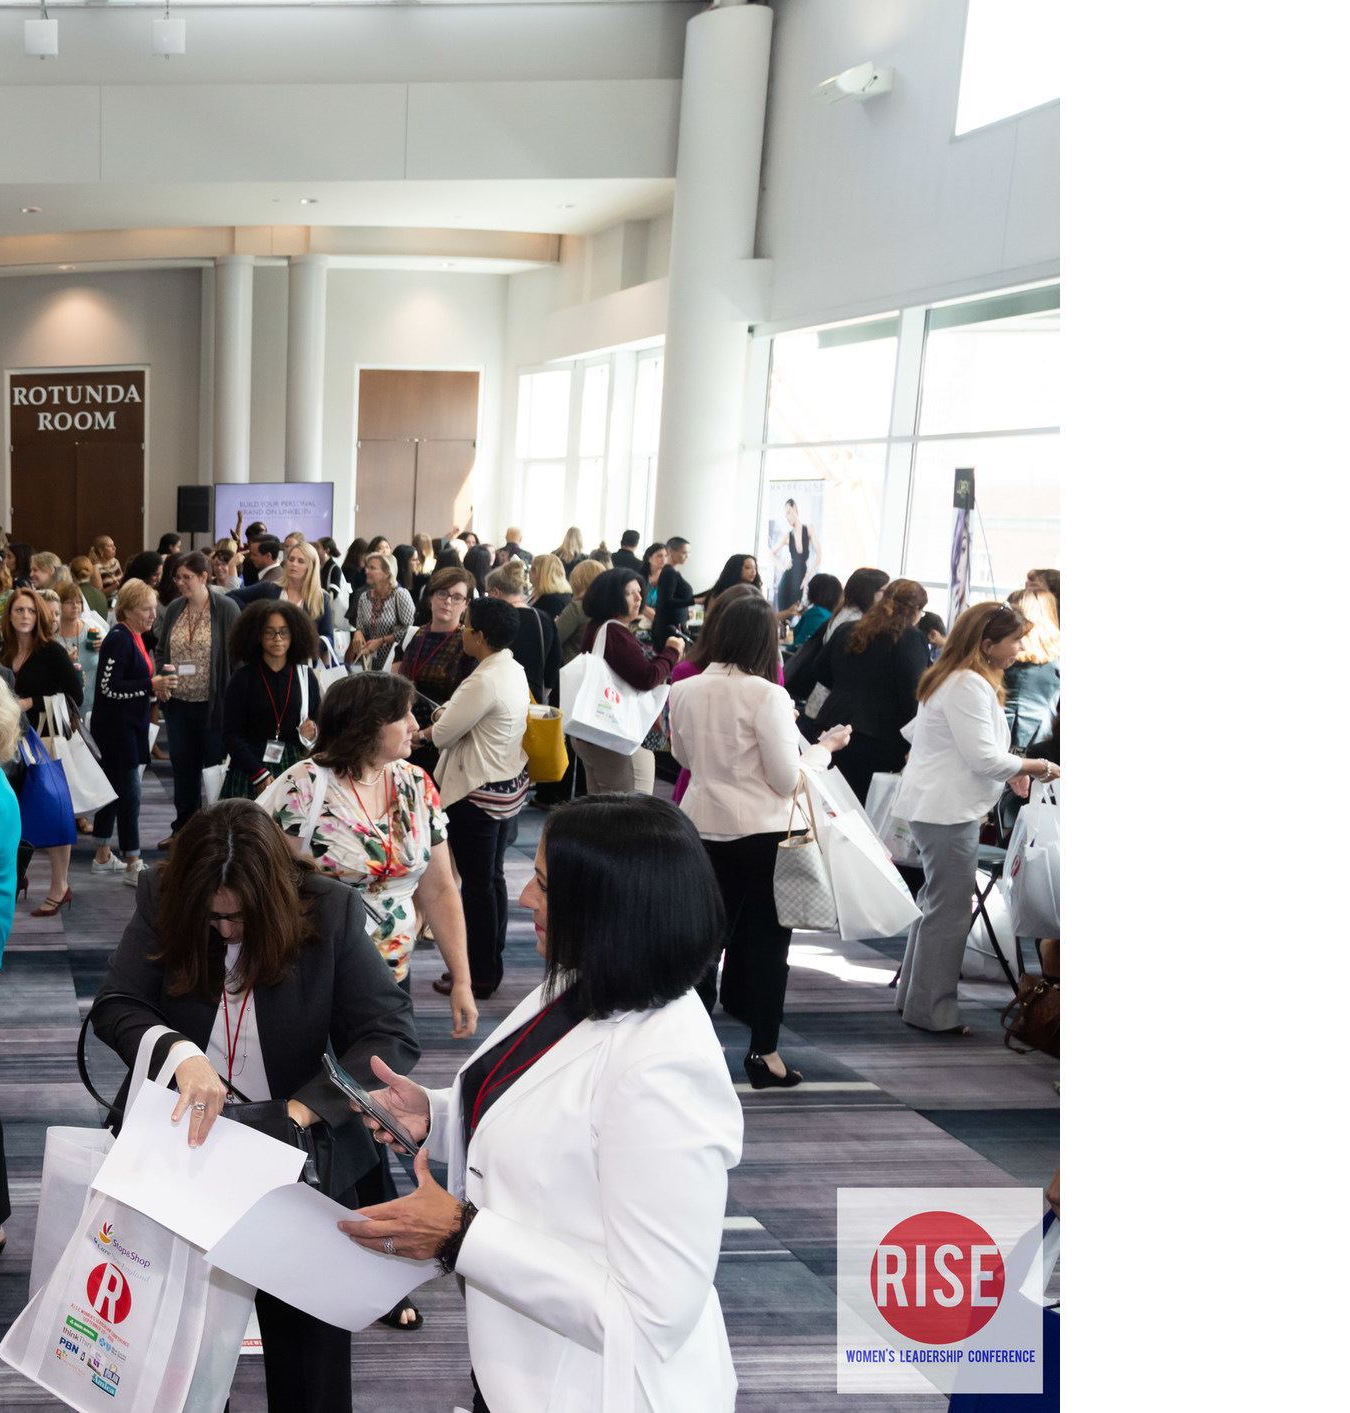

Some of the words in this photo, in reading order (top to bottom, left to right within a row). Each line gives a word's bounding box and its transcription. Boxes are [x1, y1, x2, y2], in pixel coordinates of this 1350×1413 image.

[12, 384, 142, 406] ROTUNDA
[37, 411, 117, 431] ROOM
[112, 1239, 151, 1268] Stop&Shop
[59, 1336, 80, 1354] PBN
